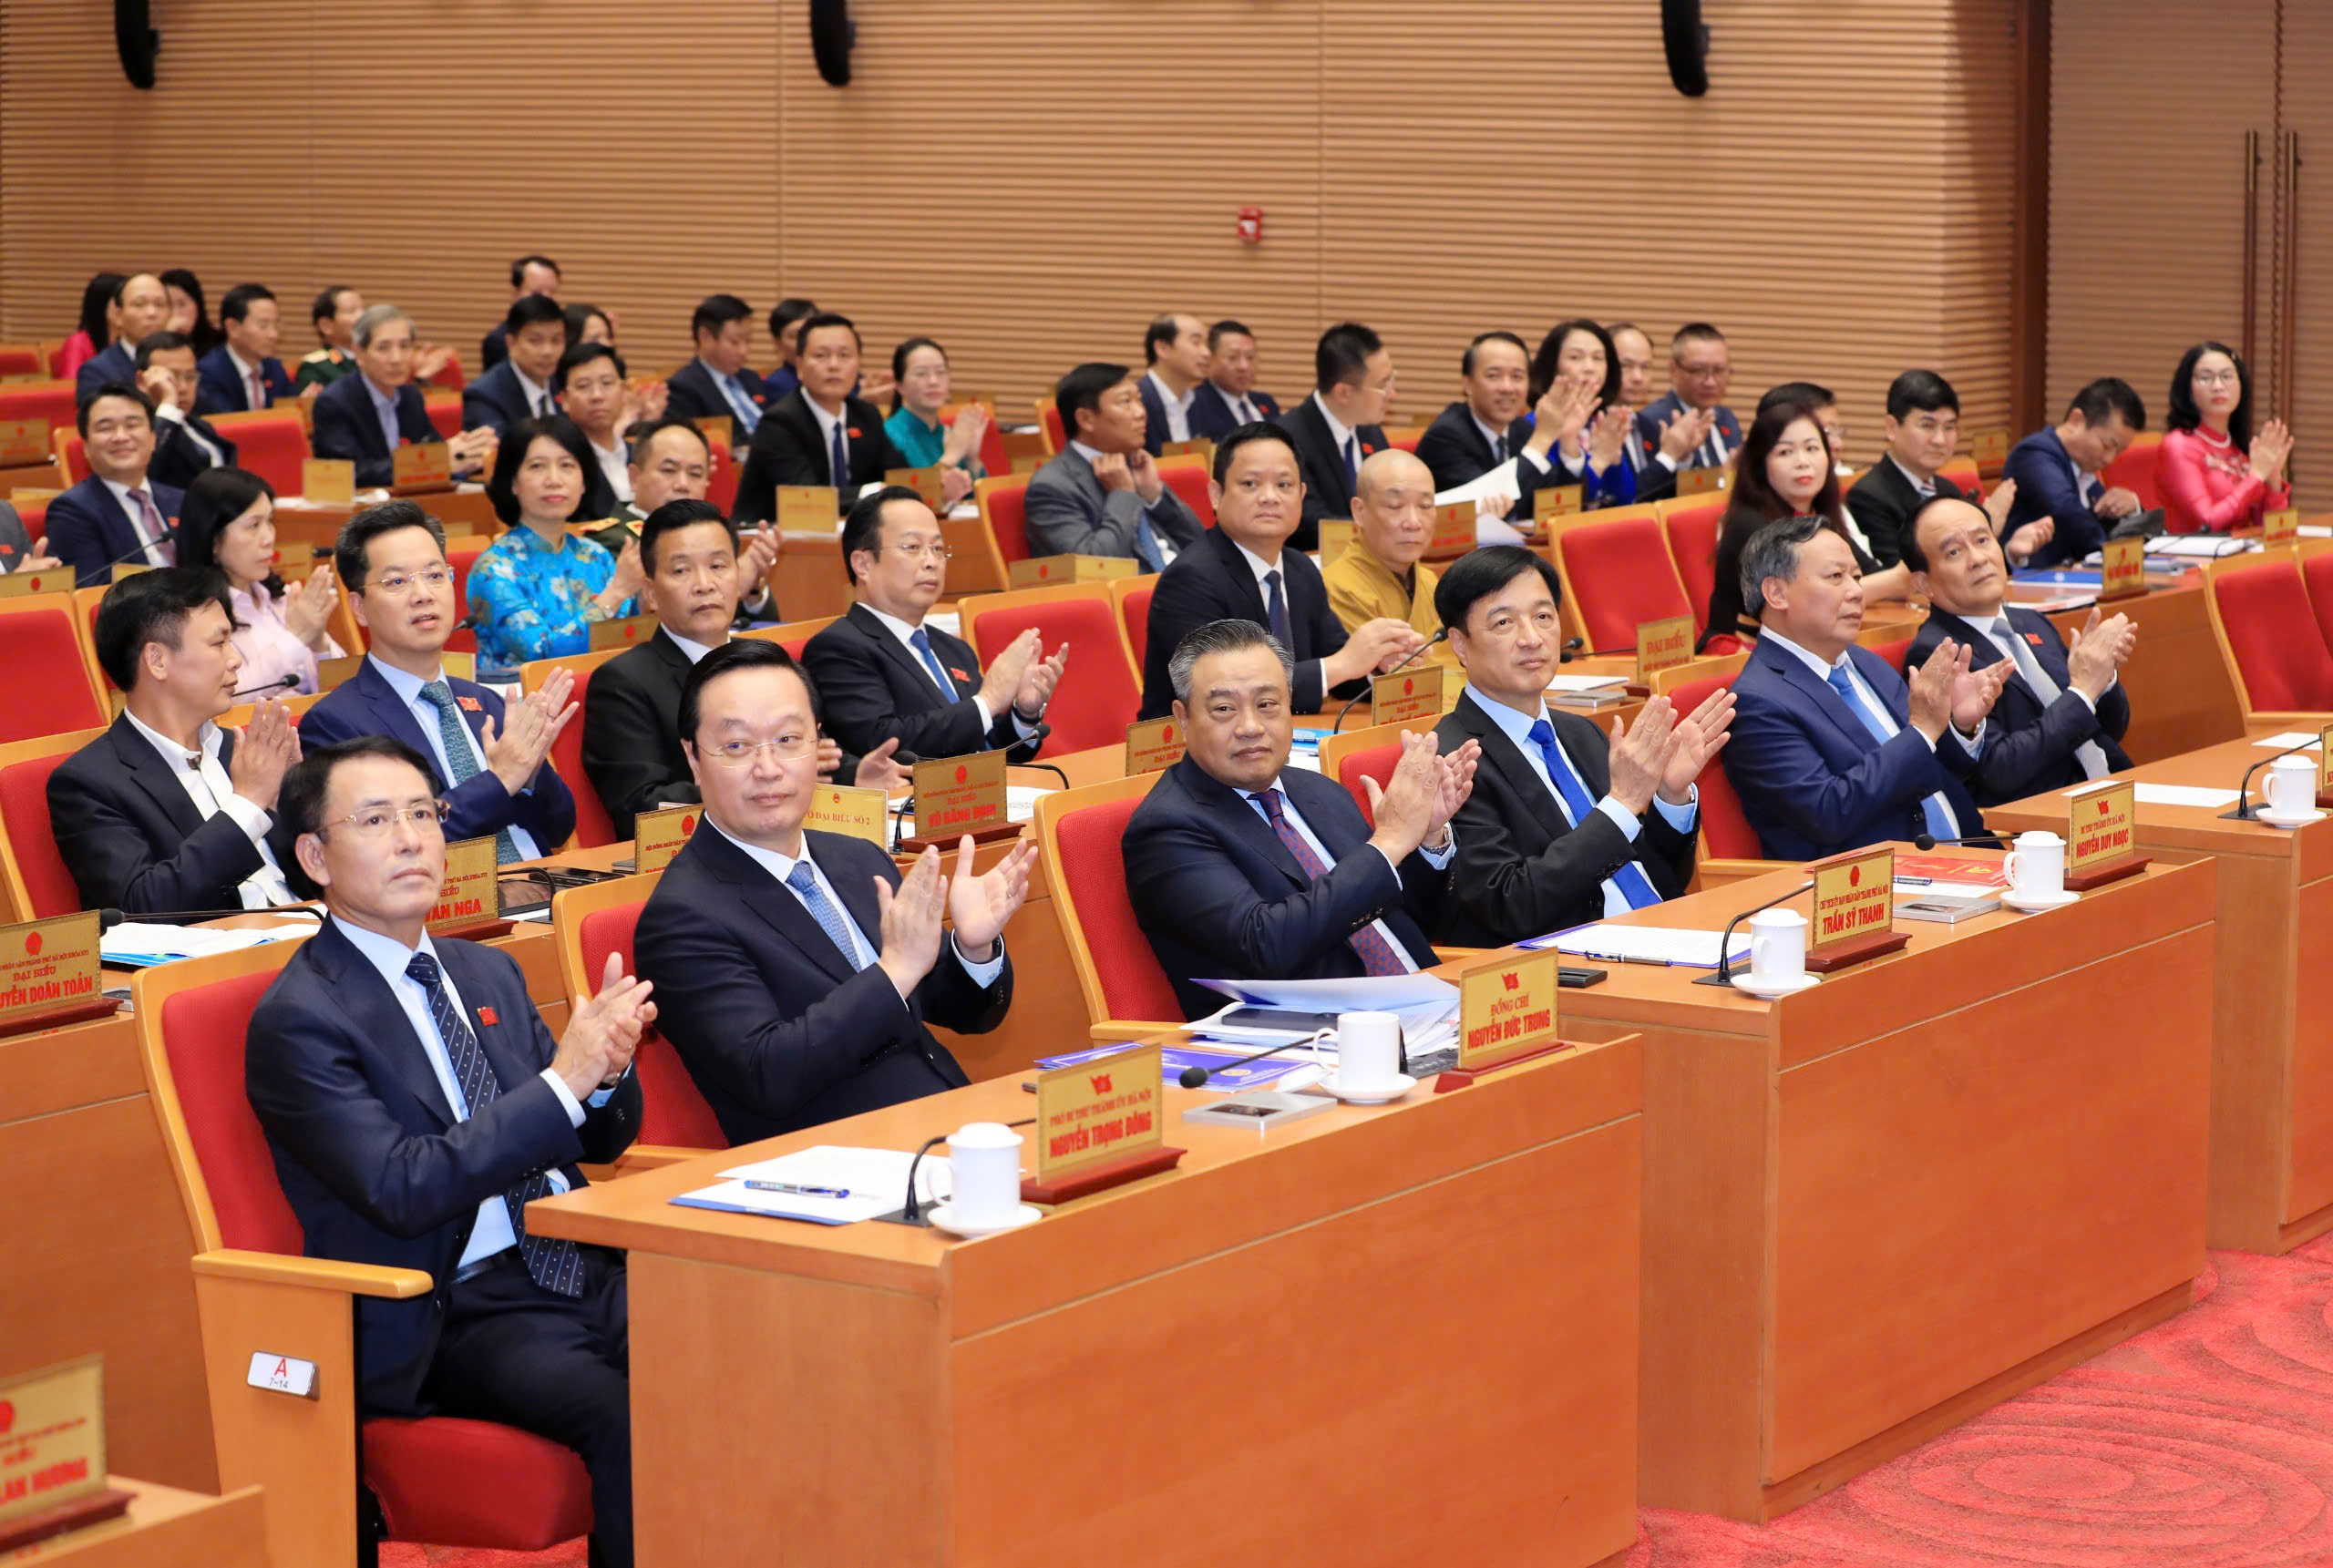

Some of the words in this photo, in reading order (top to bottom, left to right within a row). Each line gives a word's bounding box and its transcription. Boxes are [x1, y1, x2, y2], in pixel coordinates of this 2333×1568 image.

[866, 816, 871, 825] 2
[2076, 833, 2100, 859] NGUYỄN
[2101, 833, 2112, 852] DUY
[2113, 827, 2129, 848] NGỌC
[454, 898, 482, 917] NGA
[1823, 908, 1844, 935] TRẦN
[1858, 902, 1884, 927] THANH
[63, 970, 93, 997] TOẢN
[1490, 998, 1513, 1017] ĐỒNG
[1515, 990, 1529, 1010] CHÍ
[1467, 1017, 1502, 1050] NGUYỄN
[1504, 1013, 1521, 1040] ĐỨC
[1523, 1008, 1550, 1034] TRUNG
[1050, 1122, 1089, 1159] NGUYỄN
[1092, 1118, 1123, 1148] TRỌNG
[274, 1357, 287, 1378] A
